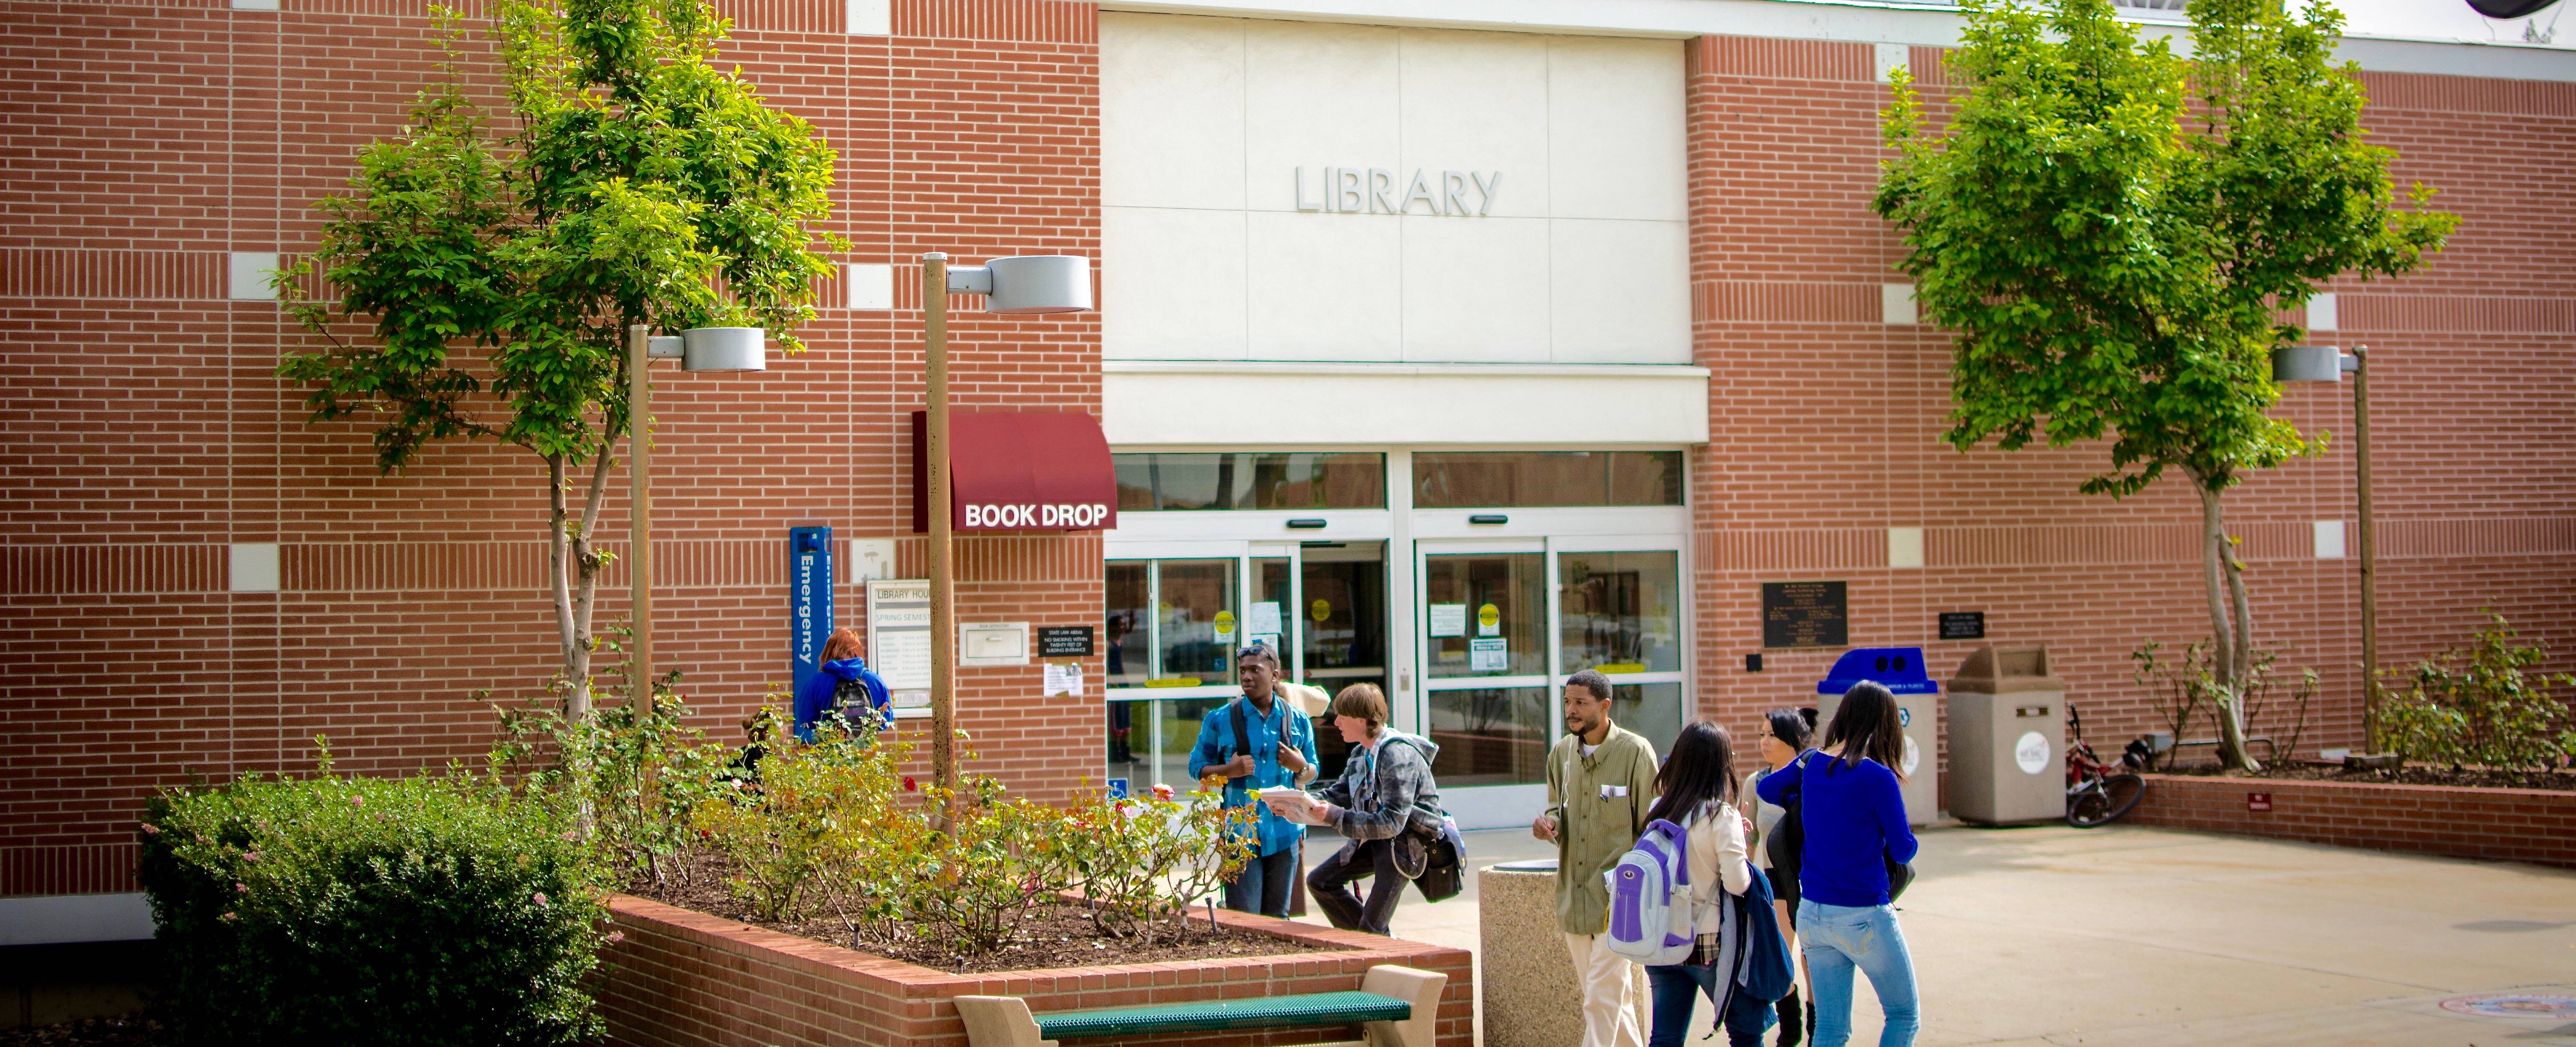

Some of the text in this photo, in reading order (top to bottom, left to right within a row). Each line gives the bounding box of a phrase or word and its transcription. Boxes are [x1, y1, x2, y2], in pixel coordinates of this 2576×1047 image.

[1296, 166, 1502, 215] LIBRARY
[966, 504, 1108, 527] BOOK DROP
[799, 556, 813, 664] Emergency
[878, 590, 930, 599] LIBRARY HOU
